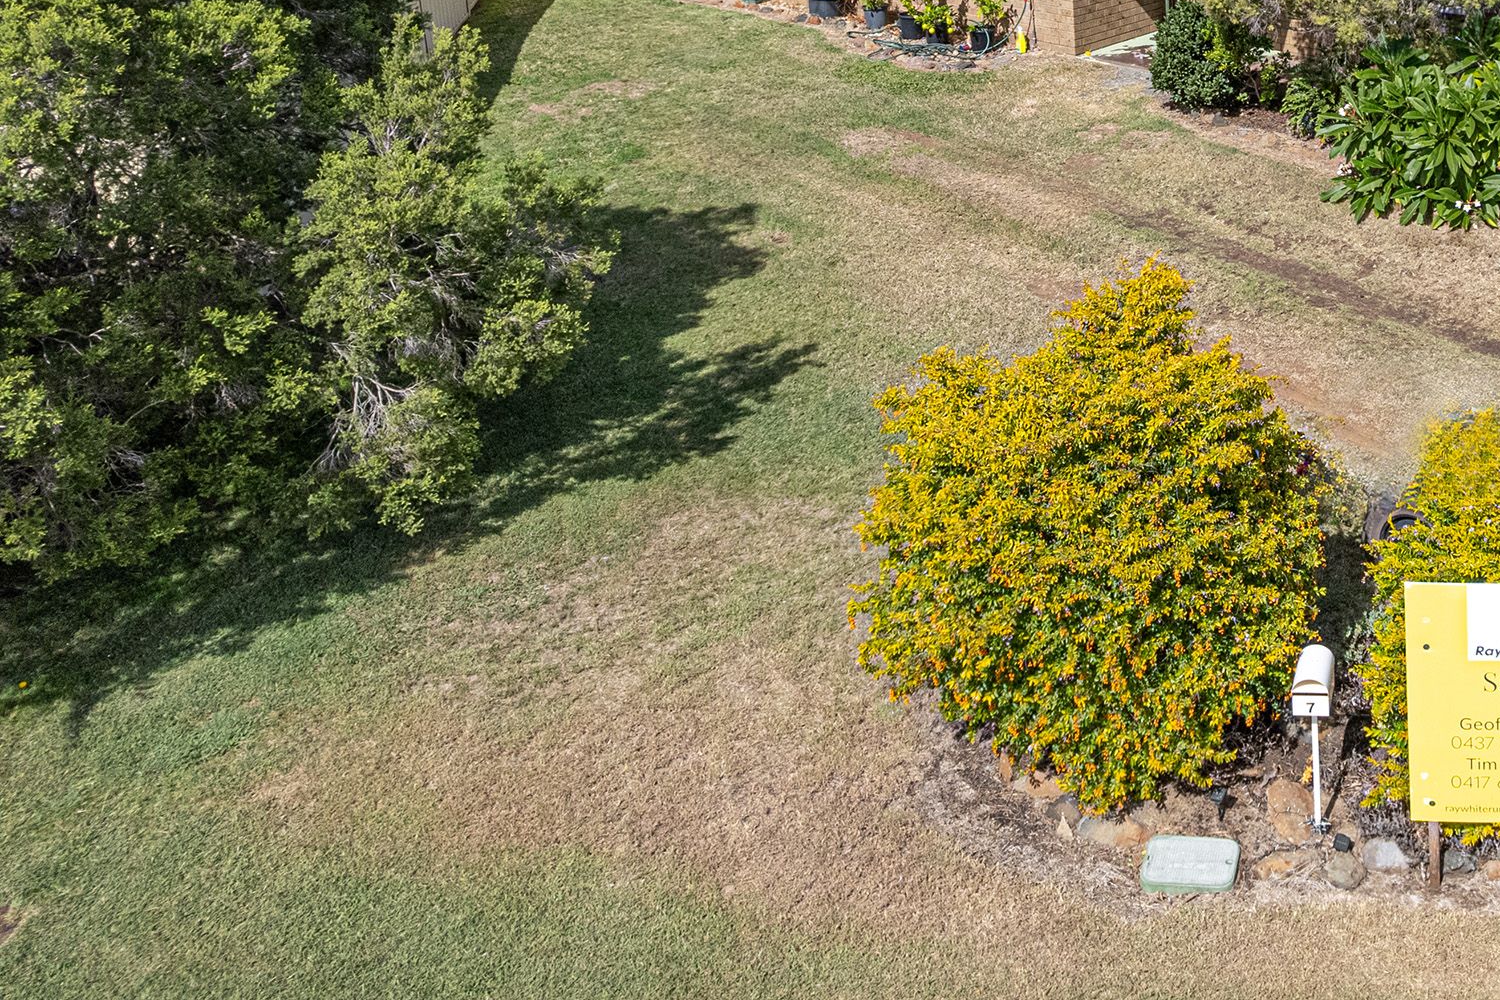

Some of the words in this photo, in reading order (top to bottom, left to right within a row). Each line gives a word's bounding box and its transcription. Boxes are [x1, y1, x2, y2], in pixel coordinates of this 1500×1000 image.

[1306, 702, 1315, 714] 7
[1450, 735, 1495, 750] 0437
[1466, 757, 1497, 771] Tim
[1450, 775, 1491, 790] 0417
